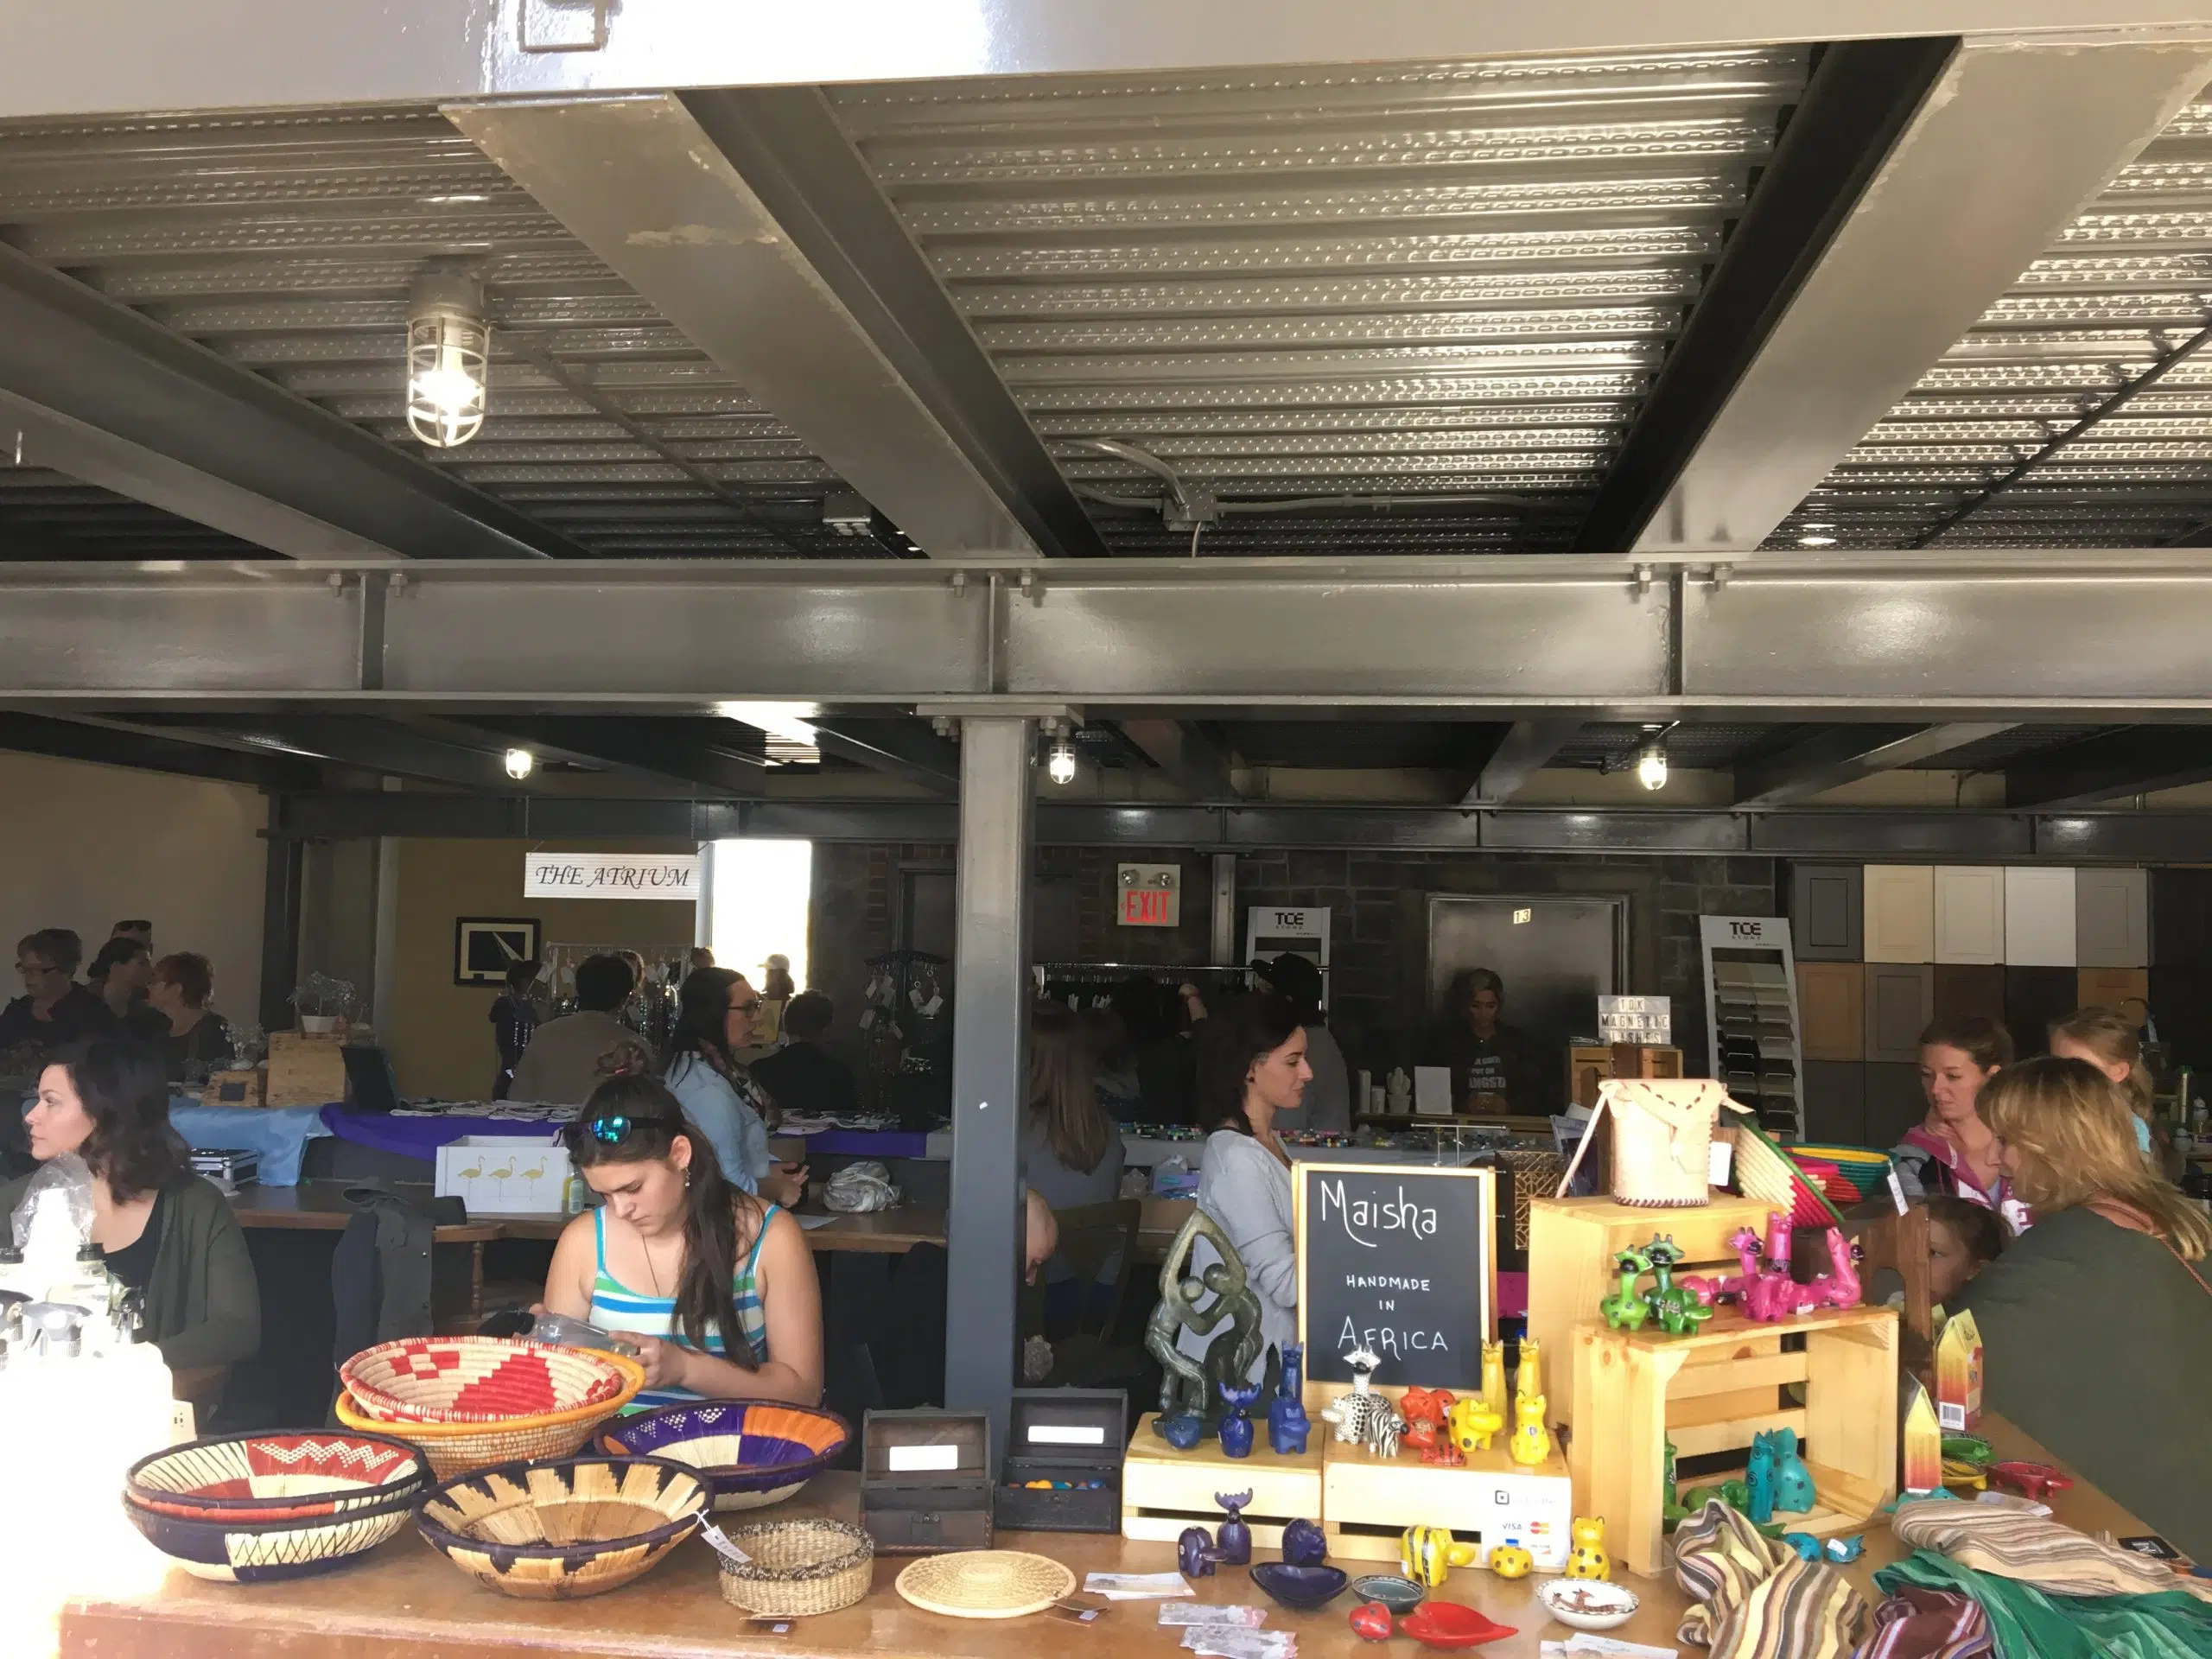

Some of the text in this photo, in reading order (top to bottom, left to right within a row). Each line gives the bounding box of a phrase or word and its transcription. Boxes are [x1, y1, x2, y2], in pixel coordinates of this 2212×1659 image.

[536, 864, 690, 889] THE ATRIUM
[1126, 890, 1172, 924] EXIT
[1274, 912, 1304, 925] TCE
[1516, 910, 1529, 923] 13
[1729, 922, 1762, 936] TCE
[1601, 1015, 1669, 1028] MAGNETIC
[1320, 1179, 1437, 1247] Maisha
[1346, 1274, 1431, 1292] HANDMADE
[1379, 1300, 1395, 1312] IN
[1338, 1316, 1449, 1361] AFRICA
[1502, 1522, 1522, 1531] VISA
